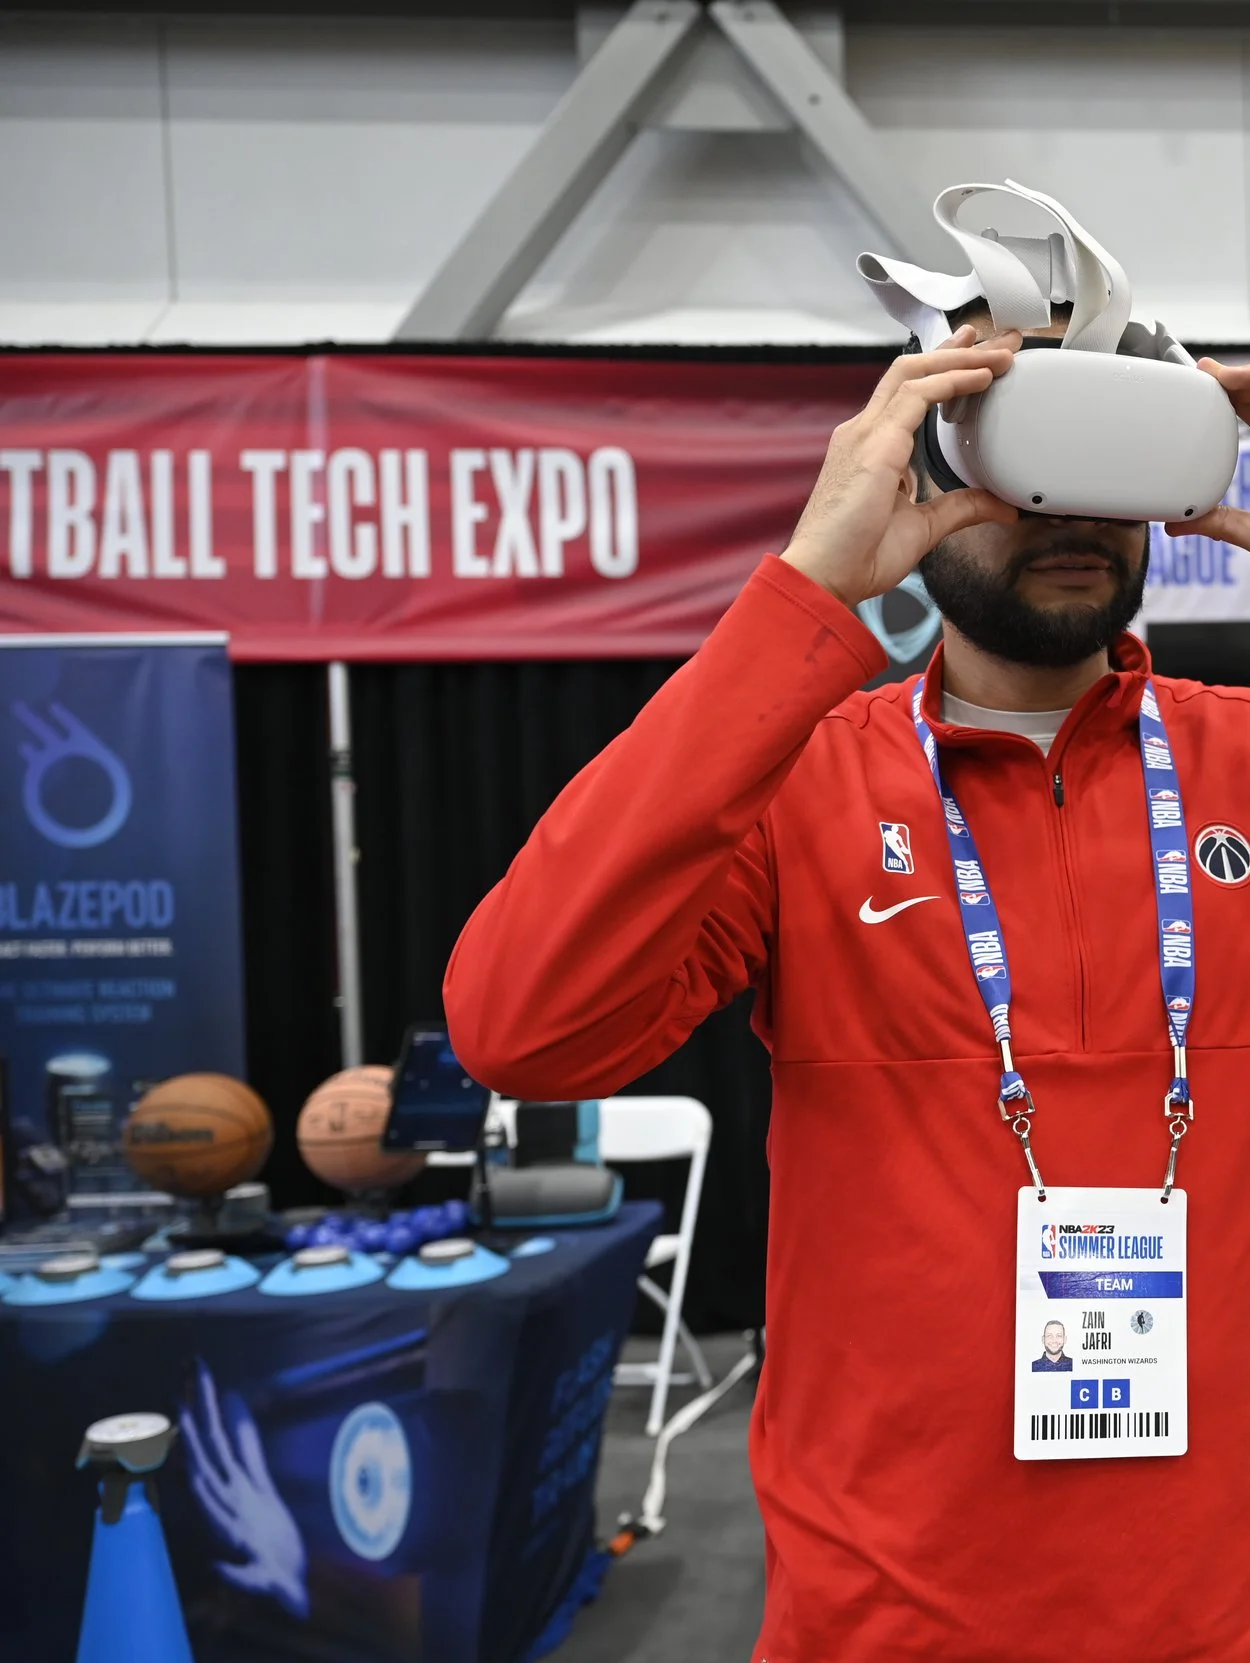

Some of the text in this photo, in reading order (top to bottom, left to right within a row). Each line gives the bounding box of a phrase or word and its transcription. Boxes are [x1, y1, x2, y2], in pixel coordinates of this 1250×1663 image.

[0, 446, 639, 579] TBALL TECH EXPO
[1144, 743, 1173, 770] NBA
[1151, 801, 1182, 829] NBA
[887, 858, 903, 869] NBA
[954, 859, 986, 891] NBA
[1158, 863, 1188, 894] NBA
[968, 930, 1003, 966] NBA
[1162, 934, 1192, 968] NBA
[1059, 1224, 1115, 1234] NBA2K23
[1059, 1236, 1163, 1259] SUMMER LEAGUE
[1095, 1278, 1133, 1291] TEAM
[1081, 1311, 1105, 1329] ZAIN
[1082, 1332, 1112, 1350] JAFRI
[1079, 1387, 1122, 1402] C B
